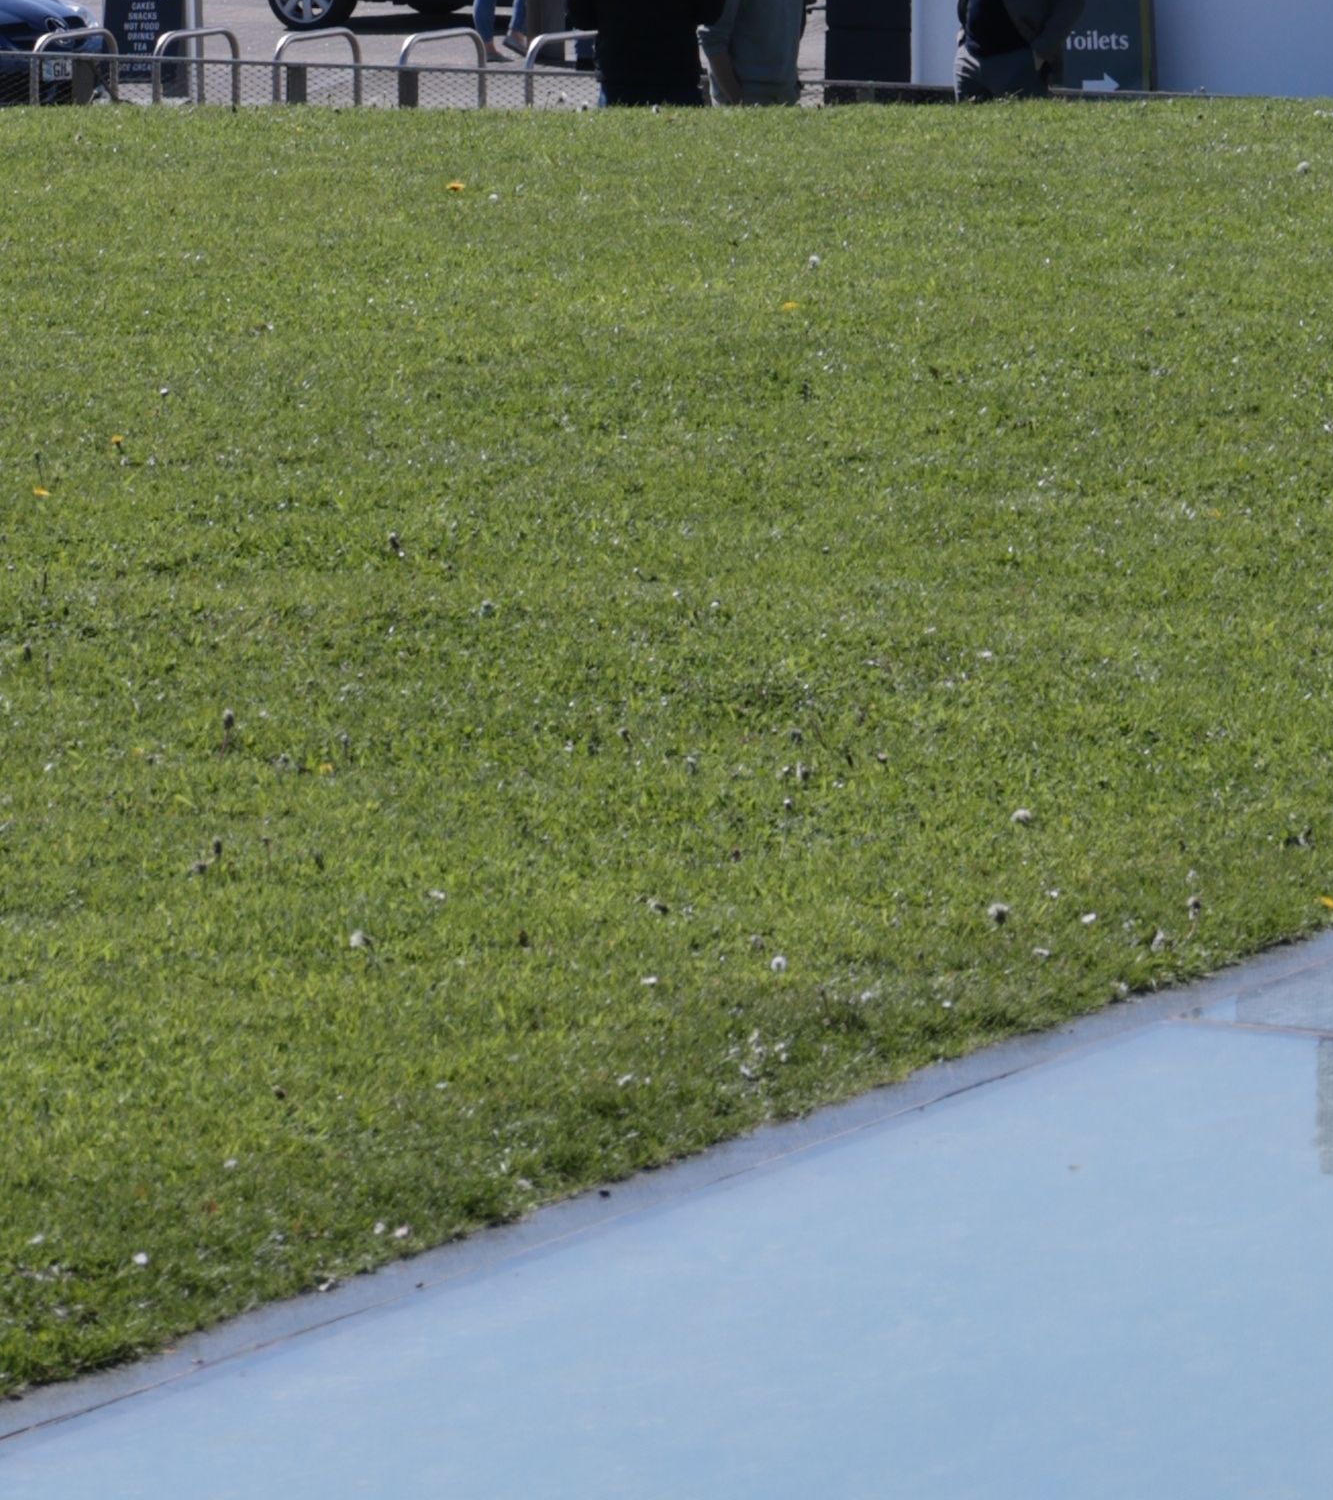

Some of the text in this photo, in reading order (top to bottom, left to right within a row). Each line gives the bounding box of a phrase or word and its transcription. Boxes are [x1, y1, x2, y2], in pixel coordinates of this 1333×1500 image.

[131, 2, 155, 10] CAKES
[128, 12, 157, 20] SNACKS
[123, 22, 160, 31] HOT FOOD
[127, 32, 155, 41] DRINKS
[1066, 29, 1129, 50] Toilets
[133, 42, 147, 51] TEA
[132, 63, 153, 71] CREA
